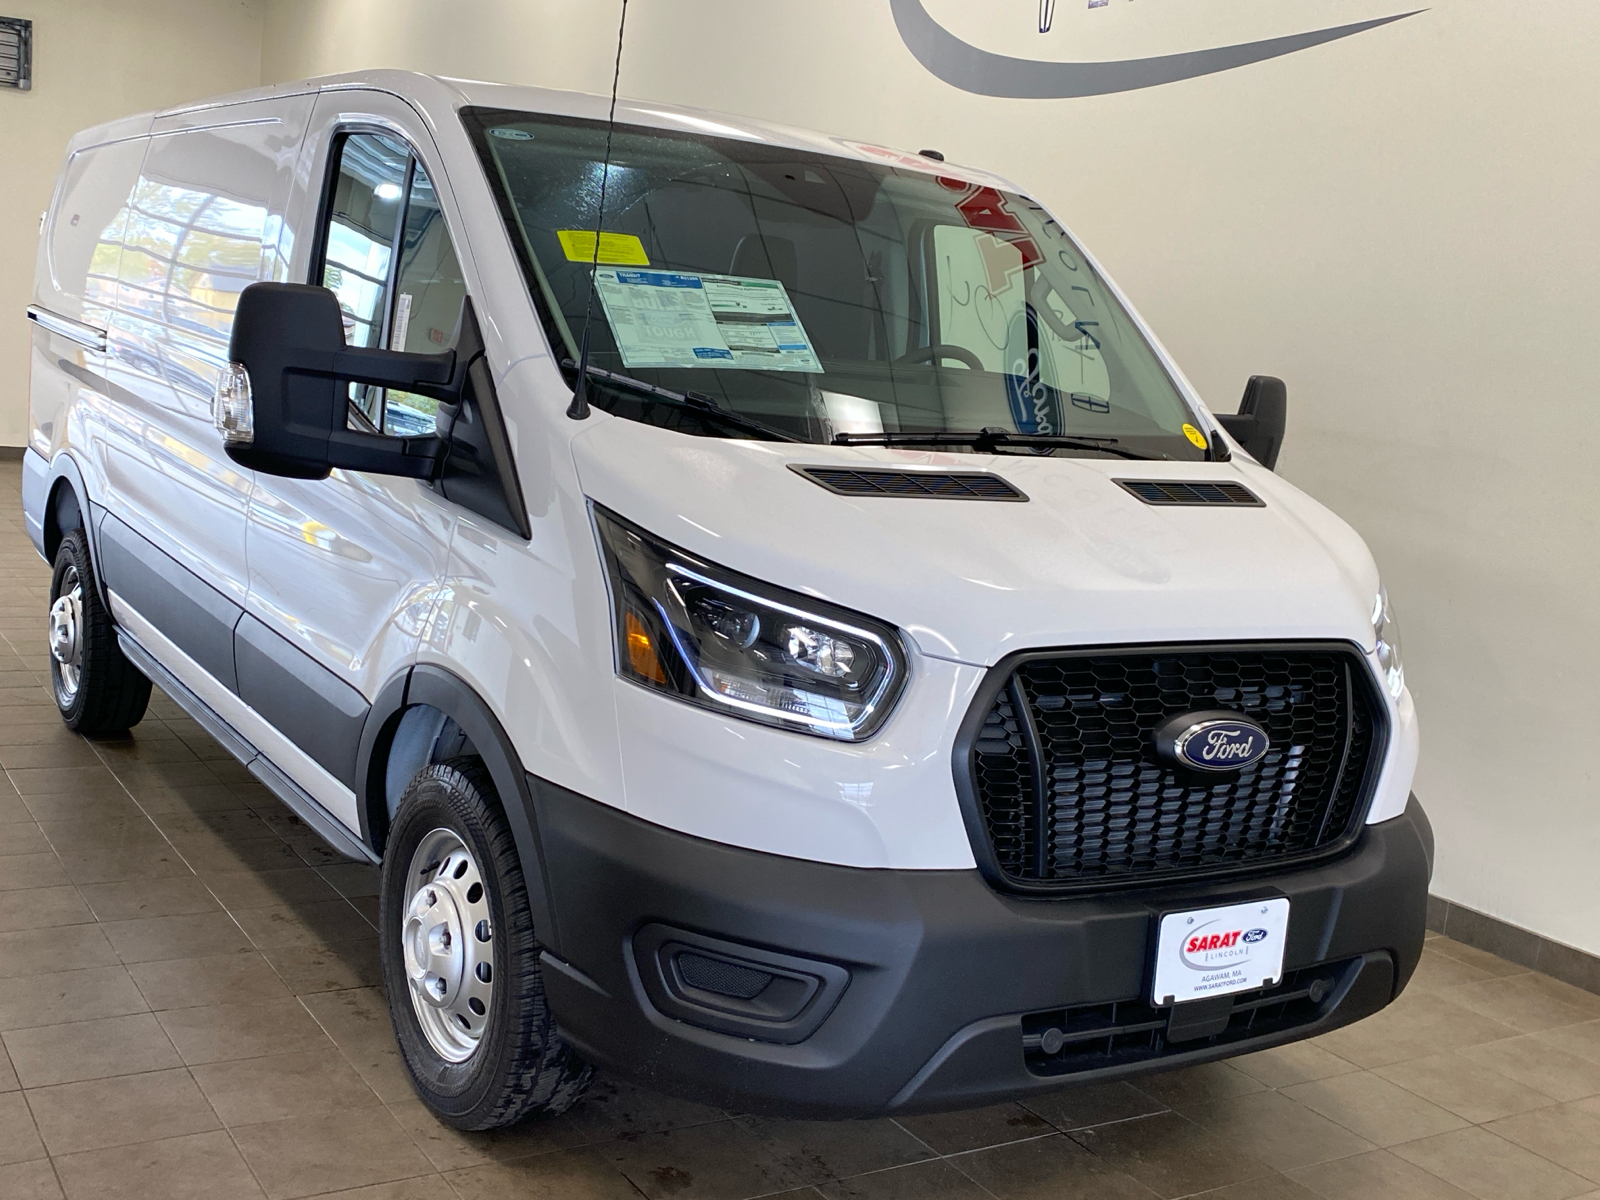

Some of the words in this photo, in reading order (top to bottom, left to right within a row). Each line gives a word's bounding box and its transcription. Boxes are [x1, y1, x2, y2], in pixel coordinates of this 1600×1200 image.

[643, 325, 697, 339] TOUGH
[1202, 730, 1254, 760] Ford
[1186, 930, 1242, 954] SARAT
[1245, 930, 1264, 942] Ford
[1210, 949, 1244, 960] LINCOLN
[1201, 972, 1231, 983] AGAWAM,
